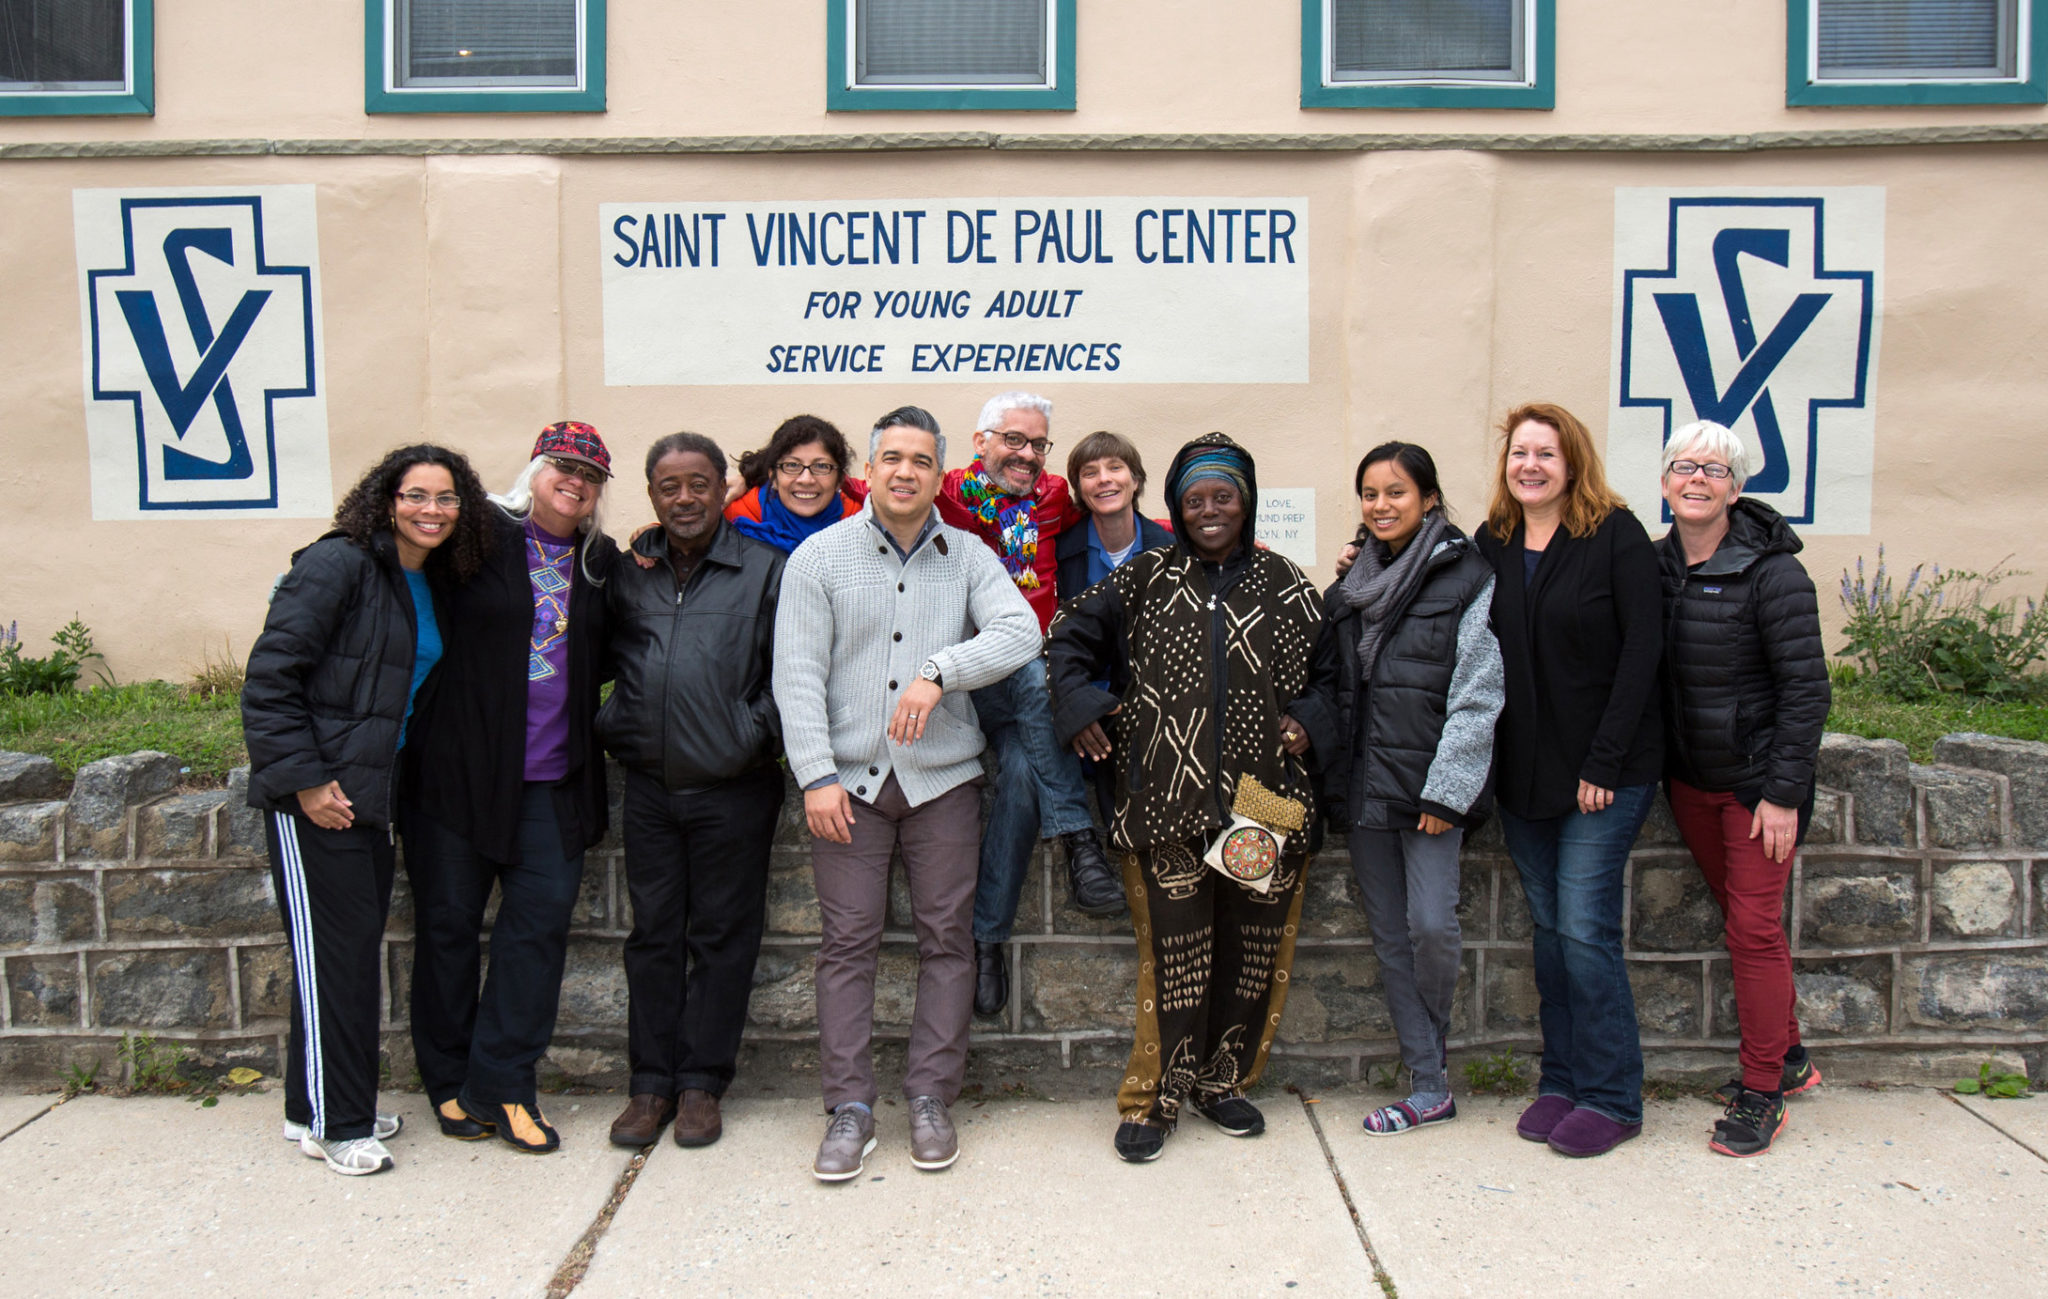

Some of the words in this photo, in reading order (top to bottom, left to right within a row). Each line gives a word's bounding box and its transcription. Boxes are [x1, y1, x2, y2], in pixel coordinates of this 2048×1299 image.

[613, 213, 726, 268] SAINT
[745, 210, 927, 267] VINCENT
[947, 209, 997, 264] DE
[1015, 209, 1114, 264] PAUL
[1135, 208, 1297, 264] CENTER
[803, 291, 862, 319] FOR
[873, 290, 971, 319] YOUNG
[984, 289, 1084, 319] ADULT
[766, 344, 886, 373] SERVICE
[911, 342, 1122, 372] EXPERIENCES
[1282, 513, 1305, 523] PREP
[1285, 529, 1299, 539] NY
